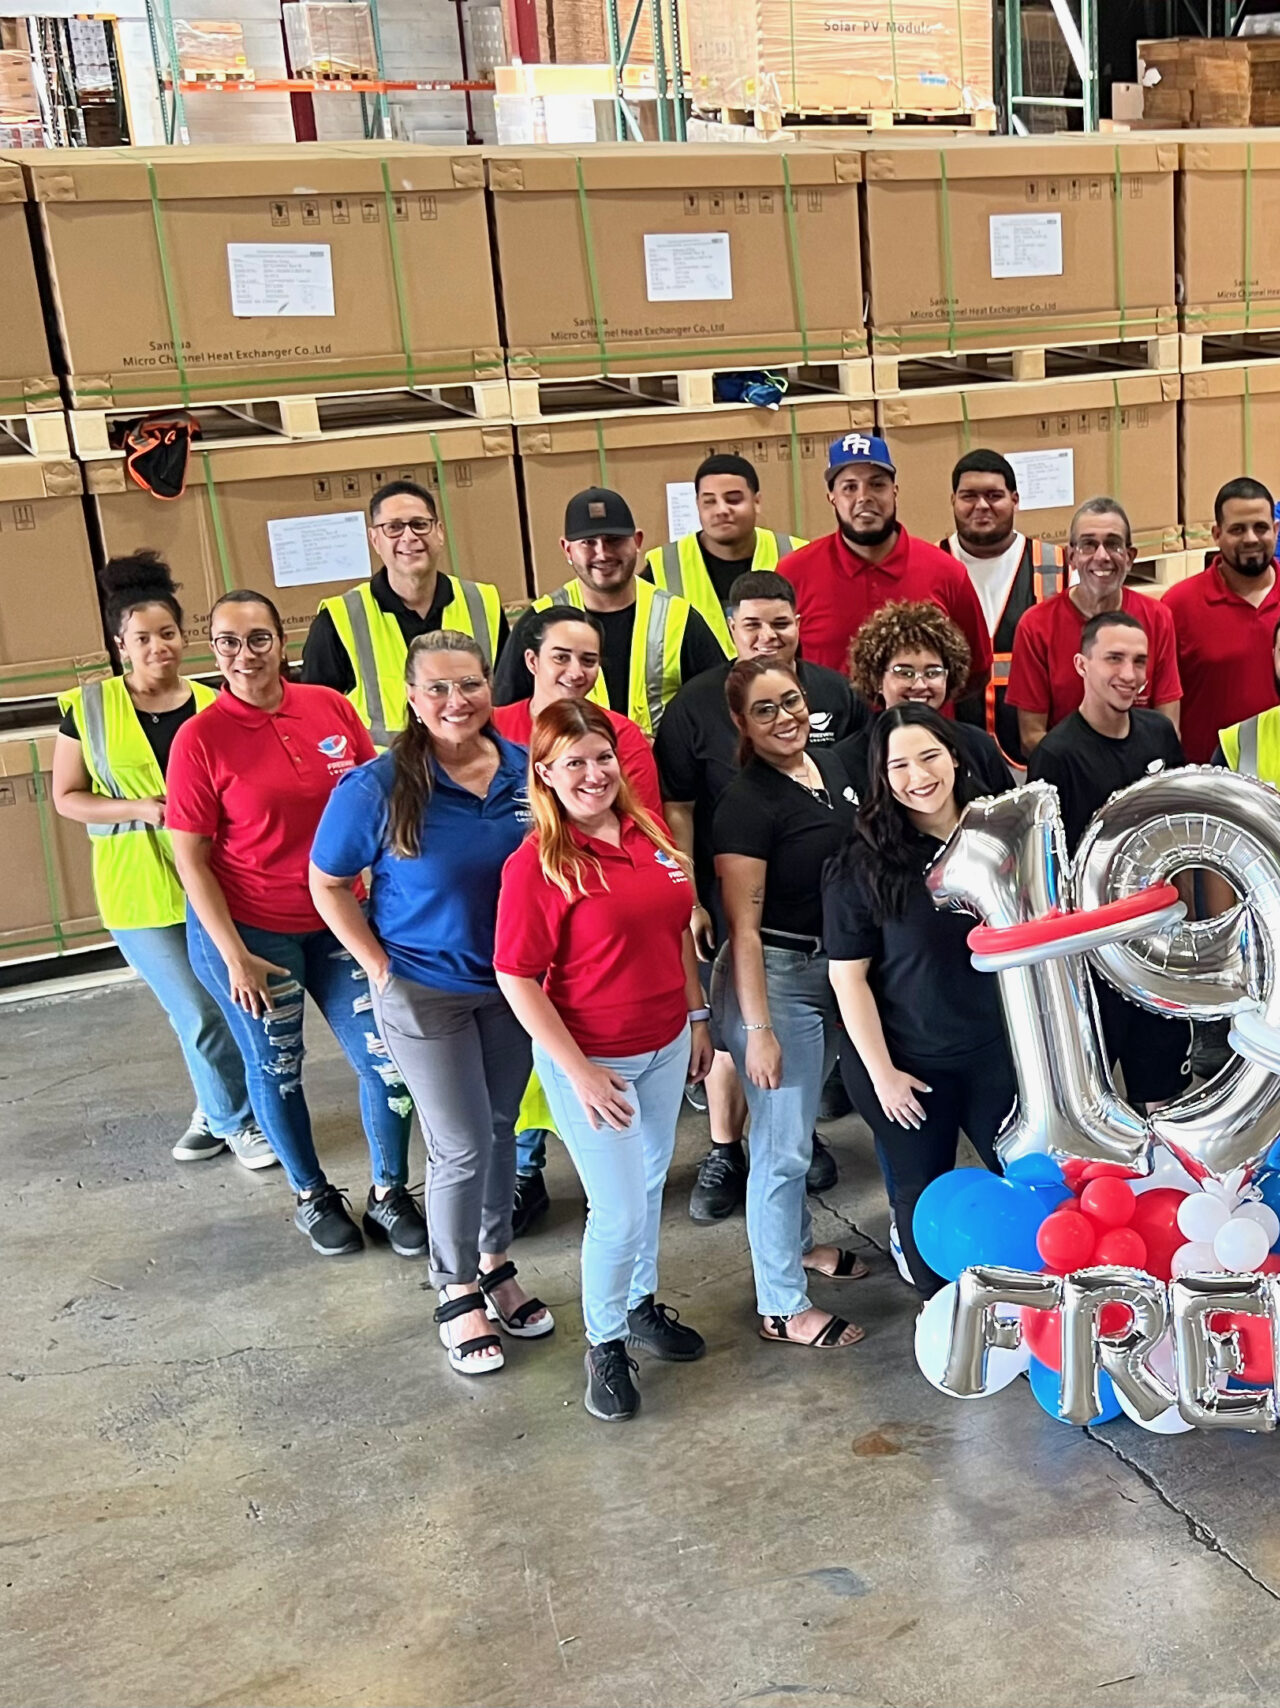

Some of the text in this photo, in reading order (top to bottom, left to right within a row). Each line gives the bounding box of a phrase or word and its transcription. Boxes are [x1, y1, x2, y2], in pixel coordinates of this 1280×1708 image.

[824, 18, 857, 33] Solar
[863, 19, 879, 33] PV
[910, 310, 934, 319] Micro
[572, 317, 609, 328] Sanha
[551, 331, 579, 341] Micro
[580, 327, 619, 340] Chanel
[620, 326, 644, 337] Heat
[644, 324, 692, 338] Exchanger
[122, 355, 157, 368] Micro
[207, 350, 234, 363] Heat
[235, 347, 292, 361] Exchanger
